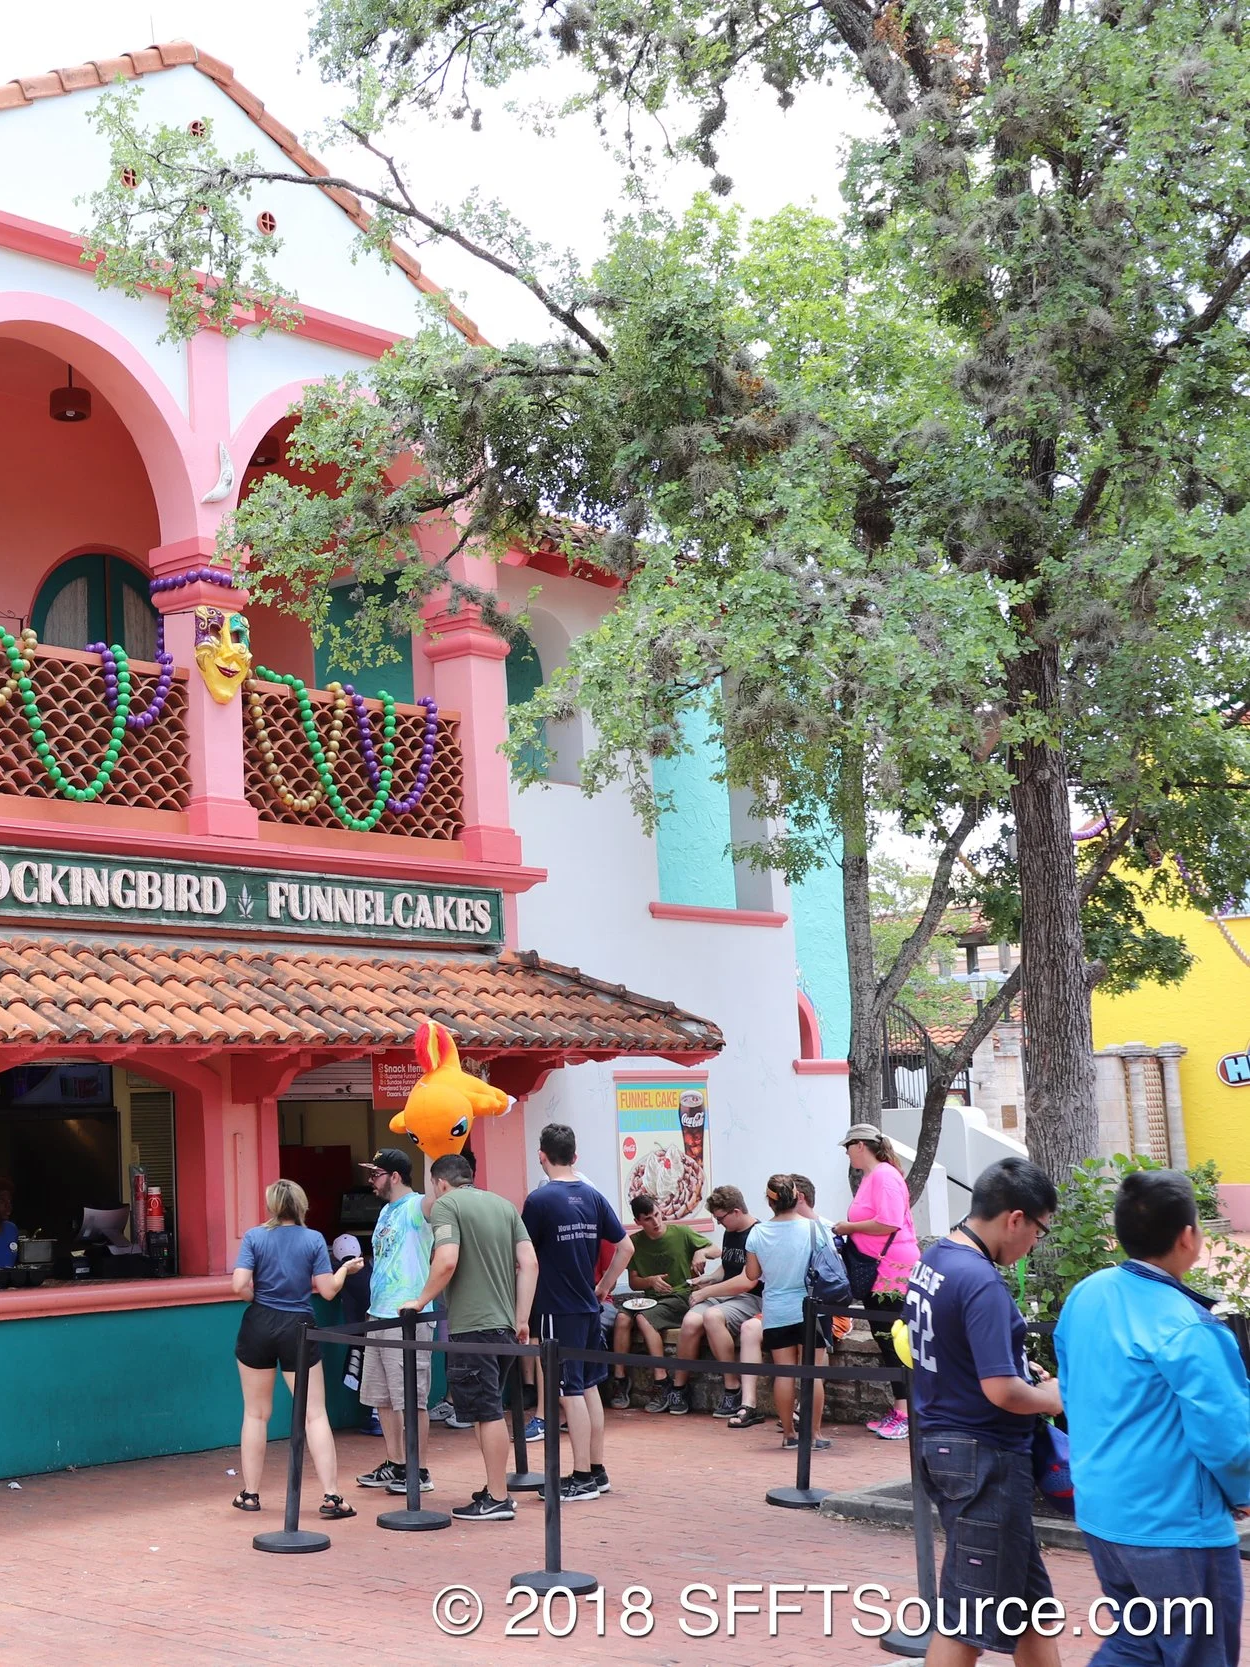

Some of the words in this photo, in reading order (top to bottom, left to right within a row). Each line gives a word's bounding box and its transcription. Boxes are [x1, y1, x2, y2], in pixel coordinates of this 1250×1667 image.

[384, 1063, 406, 1073] Snack
[620, 1091, 653, 1108] FUNNEL
[655, 1091, 678, 1108] CAKE
